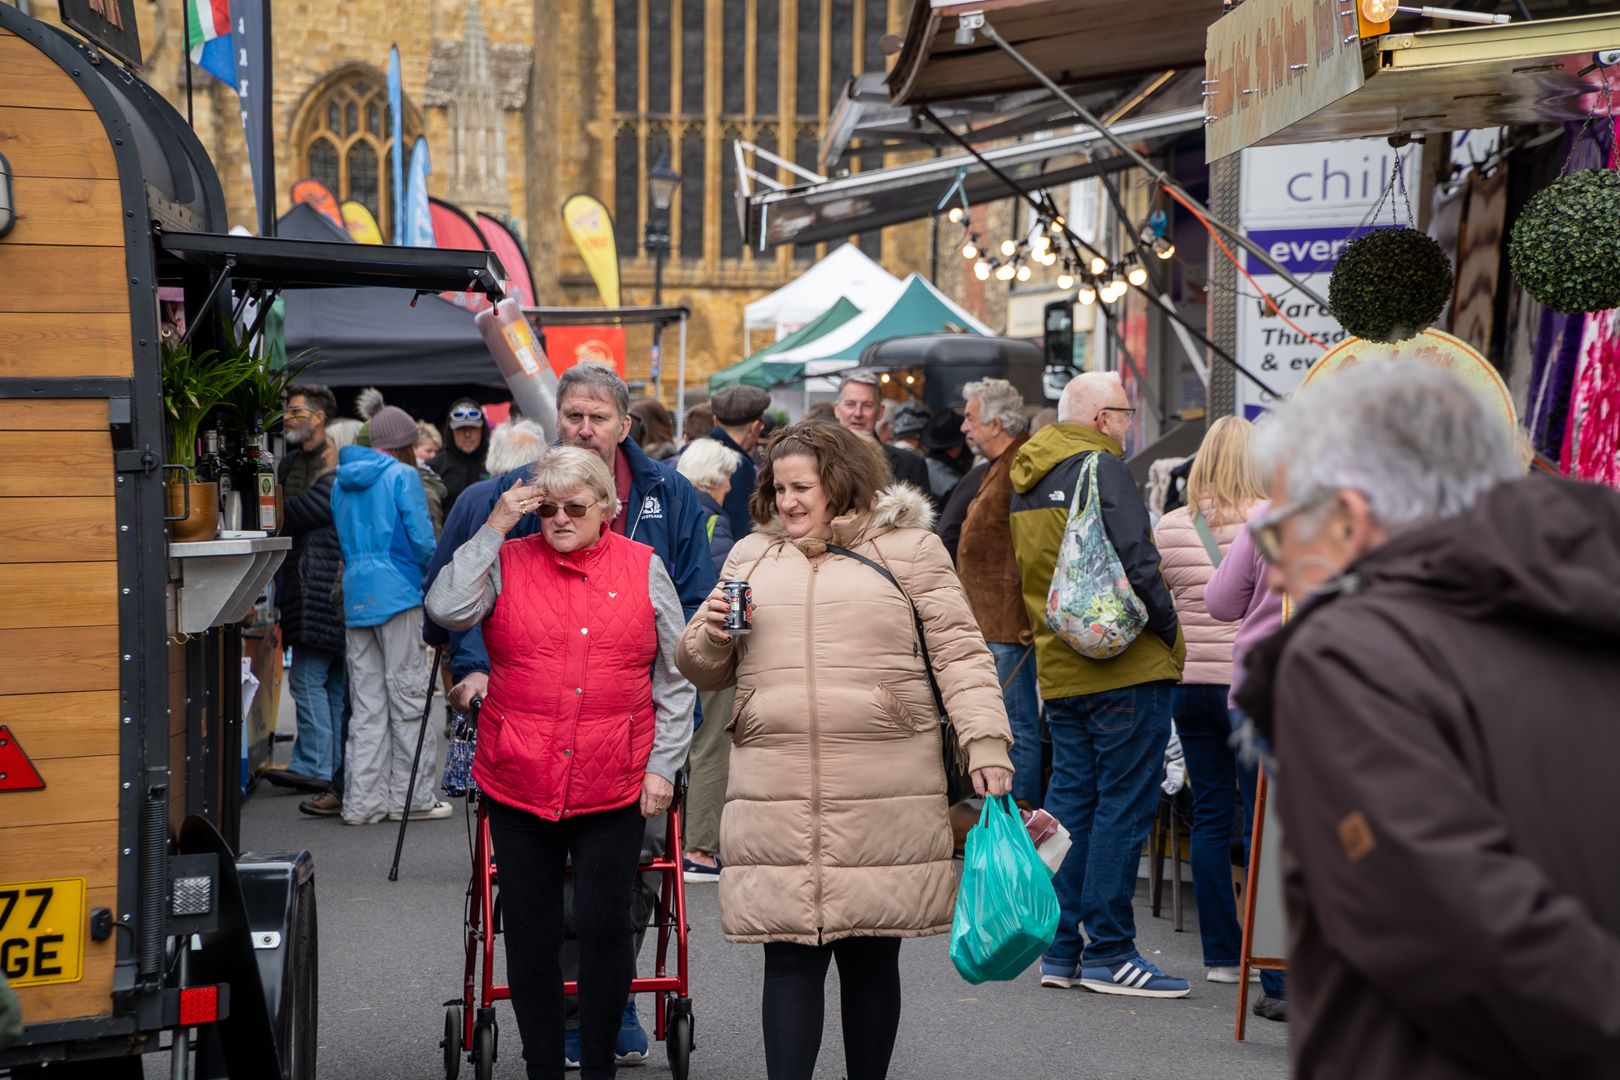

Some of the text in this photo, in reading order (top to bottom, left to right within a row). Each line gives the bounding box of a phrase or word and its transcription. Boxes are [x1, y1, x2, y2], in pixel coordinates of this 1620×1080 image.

[1287, 154, 1405, 202] chill
[1269, 238, 1352, 263] ever
[1261, 353, 1279, 371] &
